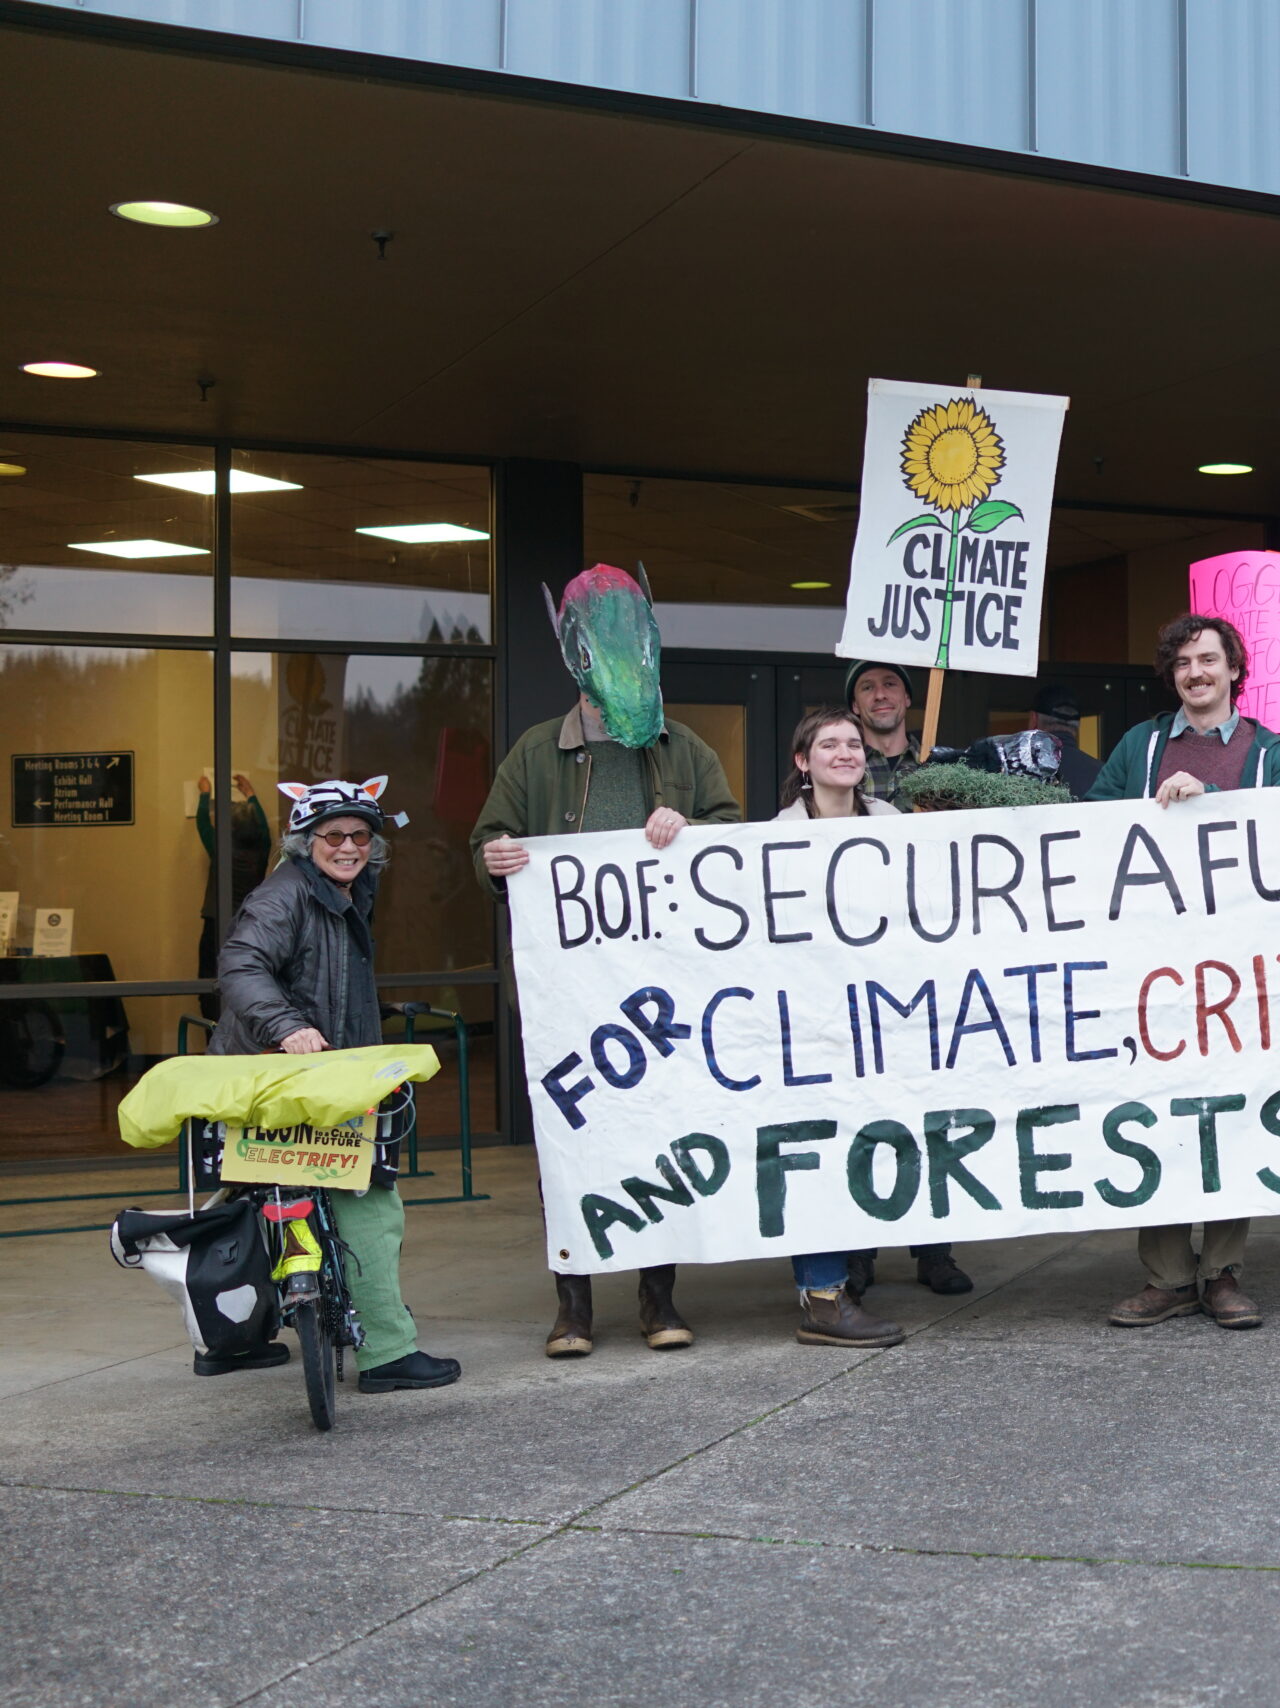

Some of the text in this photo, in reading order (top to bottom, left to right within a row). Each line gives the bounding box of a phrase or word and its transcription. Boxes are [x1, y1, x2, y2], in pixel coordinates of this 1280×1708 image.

[903, 533, 1030, 590] CLIMATE
[867, 584, 1023, 650] JUSTICE
[25, 760, 52, 771] Meeting
[55, 759, 78, 769] Rooms
[54, 774, 93, 785] Exhibit Hall
[54, 788, 78, 797] Atrium
[54, 797, 113, 809] Performance Hall
[54, 811, 81, 823] Meeting
[84, 810, 103, 820] Room
[690, 830, 1085, 951] SECURE
[1108, 823, 1187, 921] A
[541, 985, 691, 1130] FOR
[701, 960, 1138, 1092] CLIMATE,
[314, 1138, 362, 1147] FUTURE
[244, 1147, 359, 1168] ELECTRIFY!
[579, 1132, 731, 1260] AND
